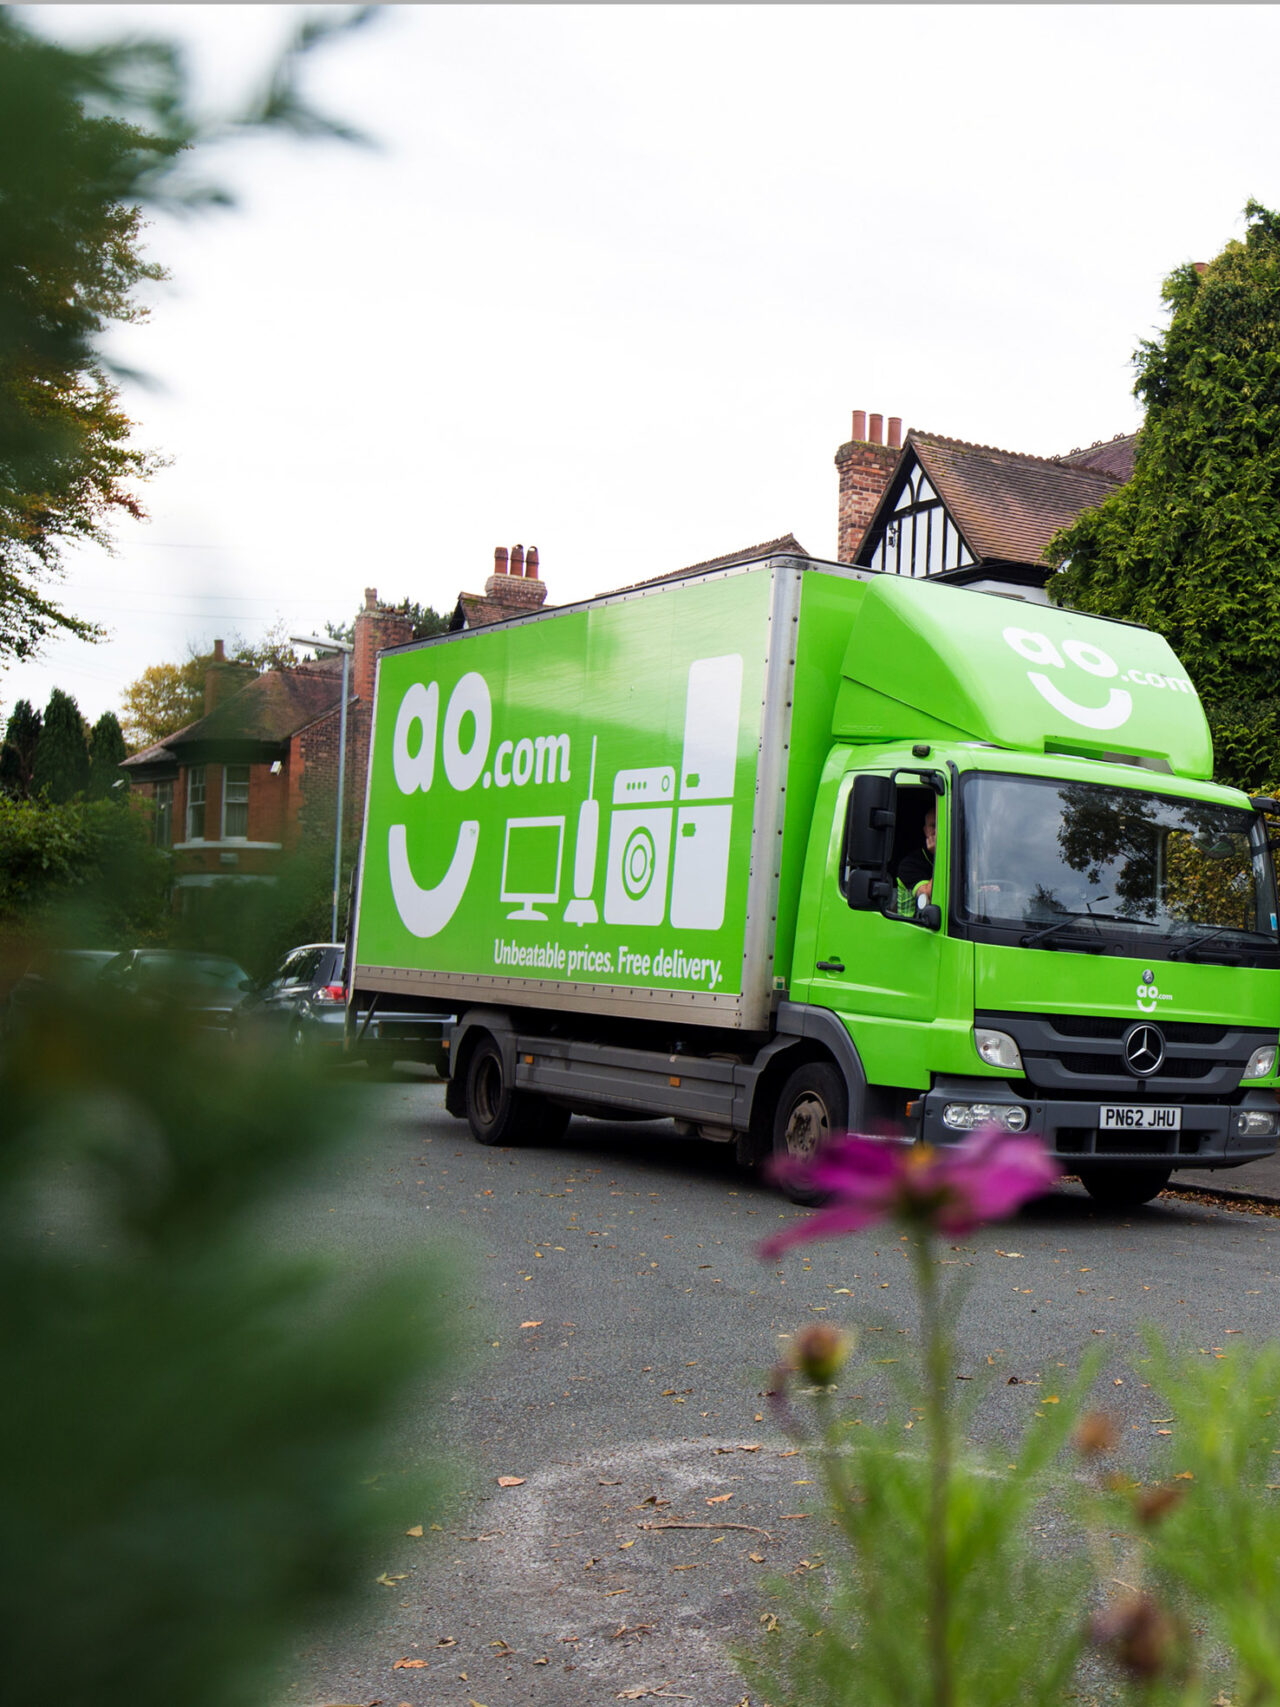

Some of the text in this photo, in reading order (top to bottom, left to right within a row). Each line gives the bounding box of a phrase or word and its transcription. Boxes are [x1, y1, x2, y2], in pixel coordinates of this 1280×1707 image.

[494, 938, 723, 989] Unbeatable prices. Free delivery.
[1106, 1109, 1176, 1127] PN62 JHU
